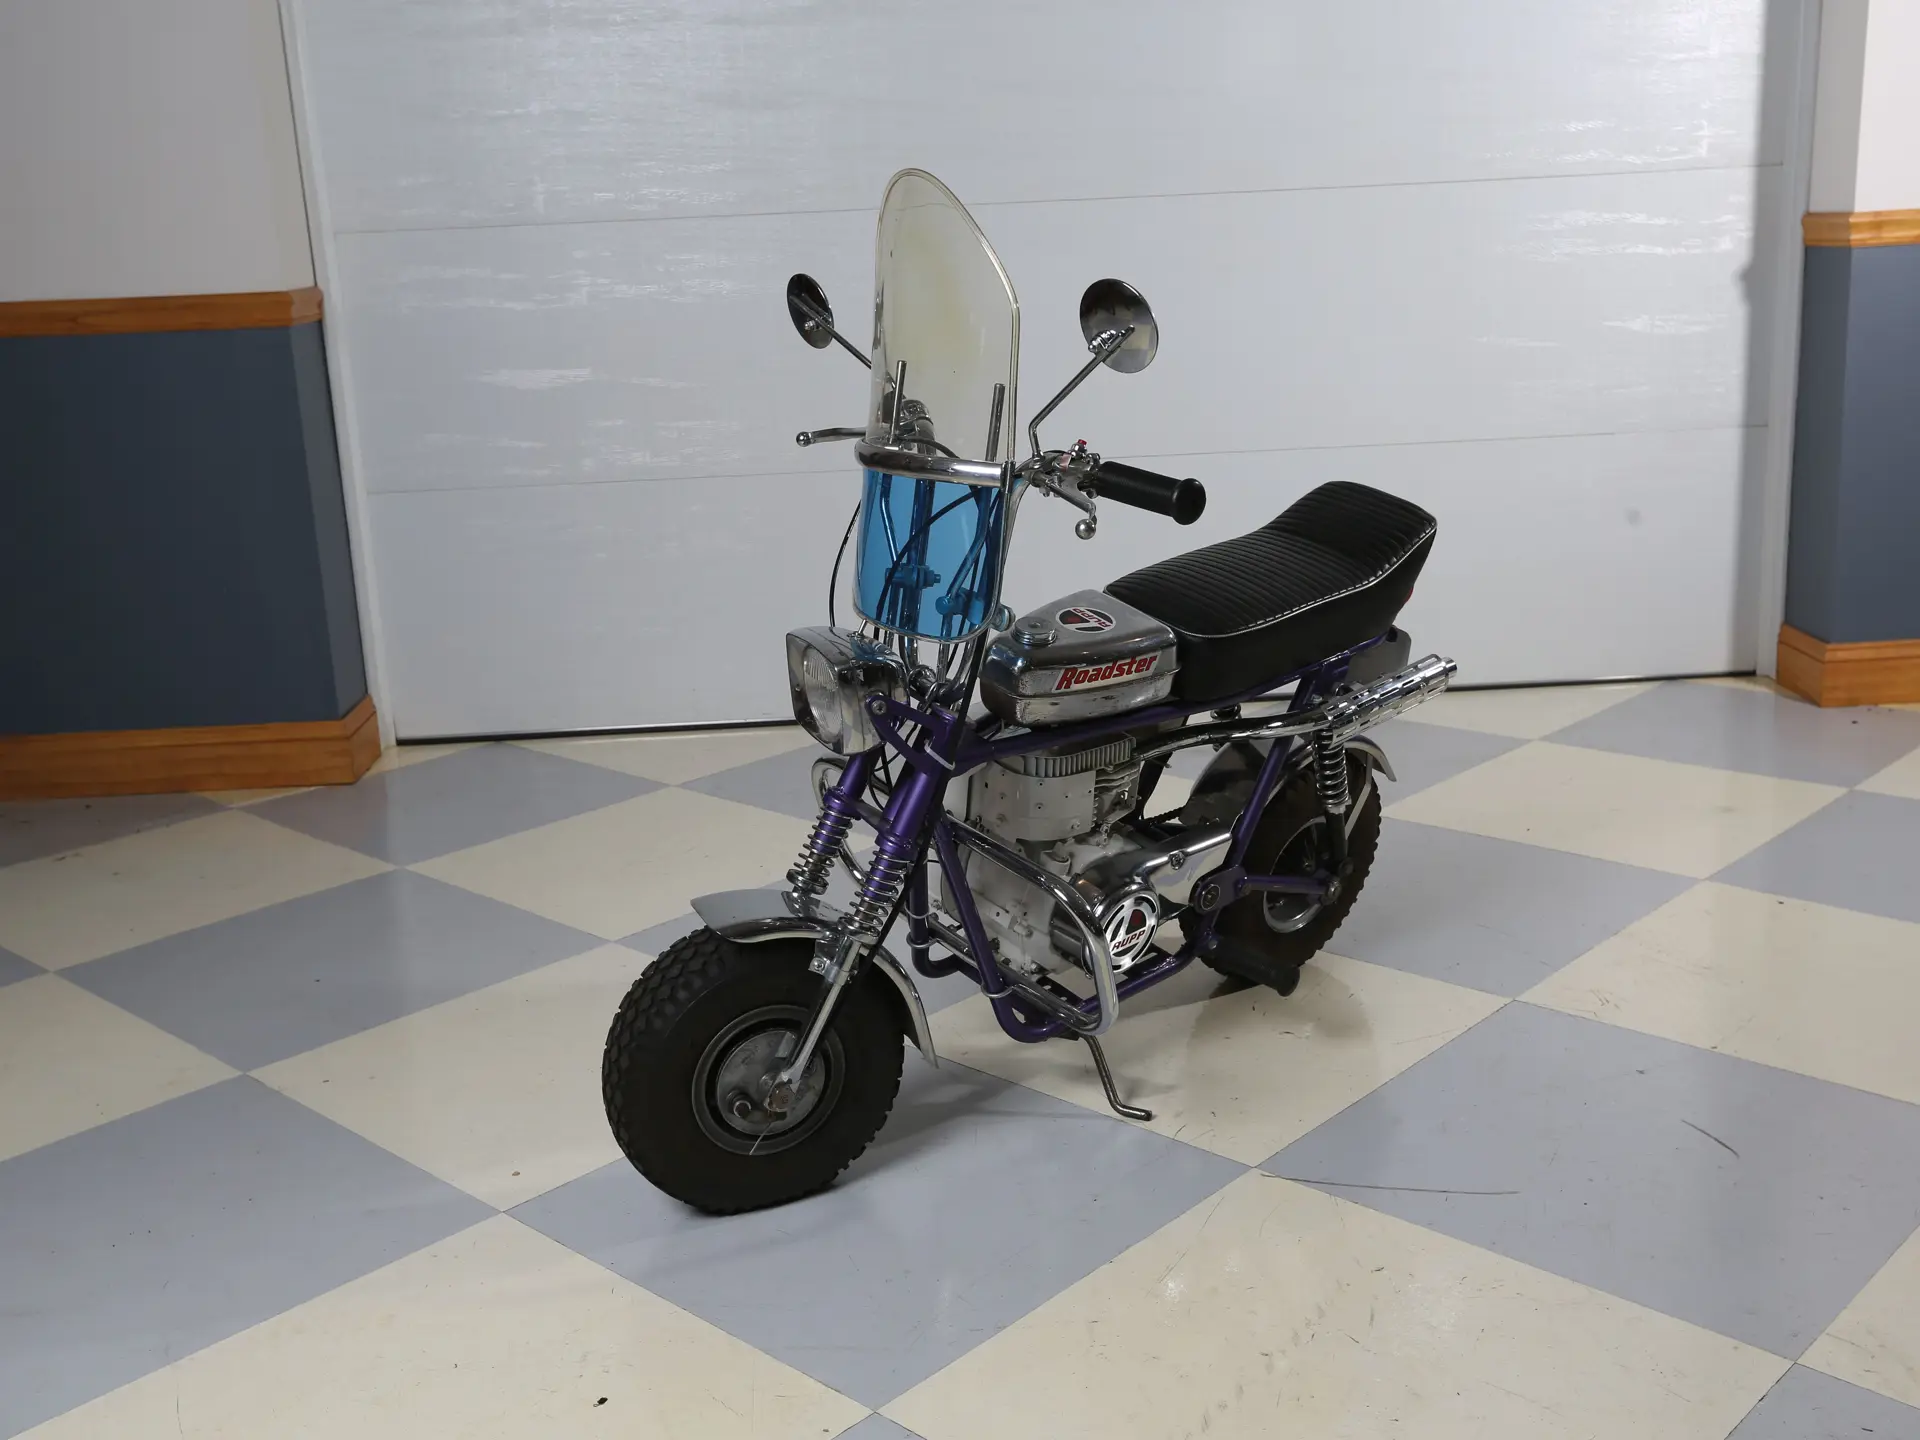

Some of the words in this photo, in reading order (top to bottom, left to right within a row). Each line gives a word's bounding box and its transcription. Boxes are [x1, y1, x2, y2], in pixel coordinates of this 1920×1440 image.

[1071, 608, 1111, 628] RUPP
[1055, 655, 1157, 690] Roadster
[1111, 929, 1146, 951] RUPP
